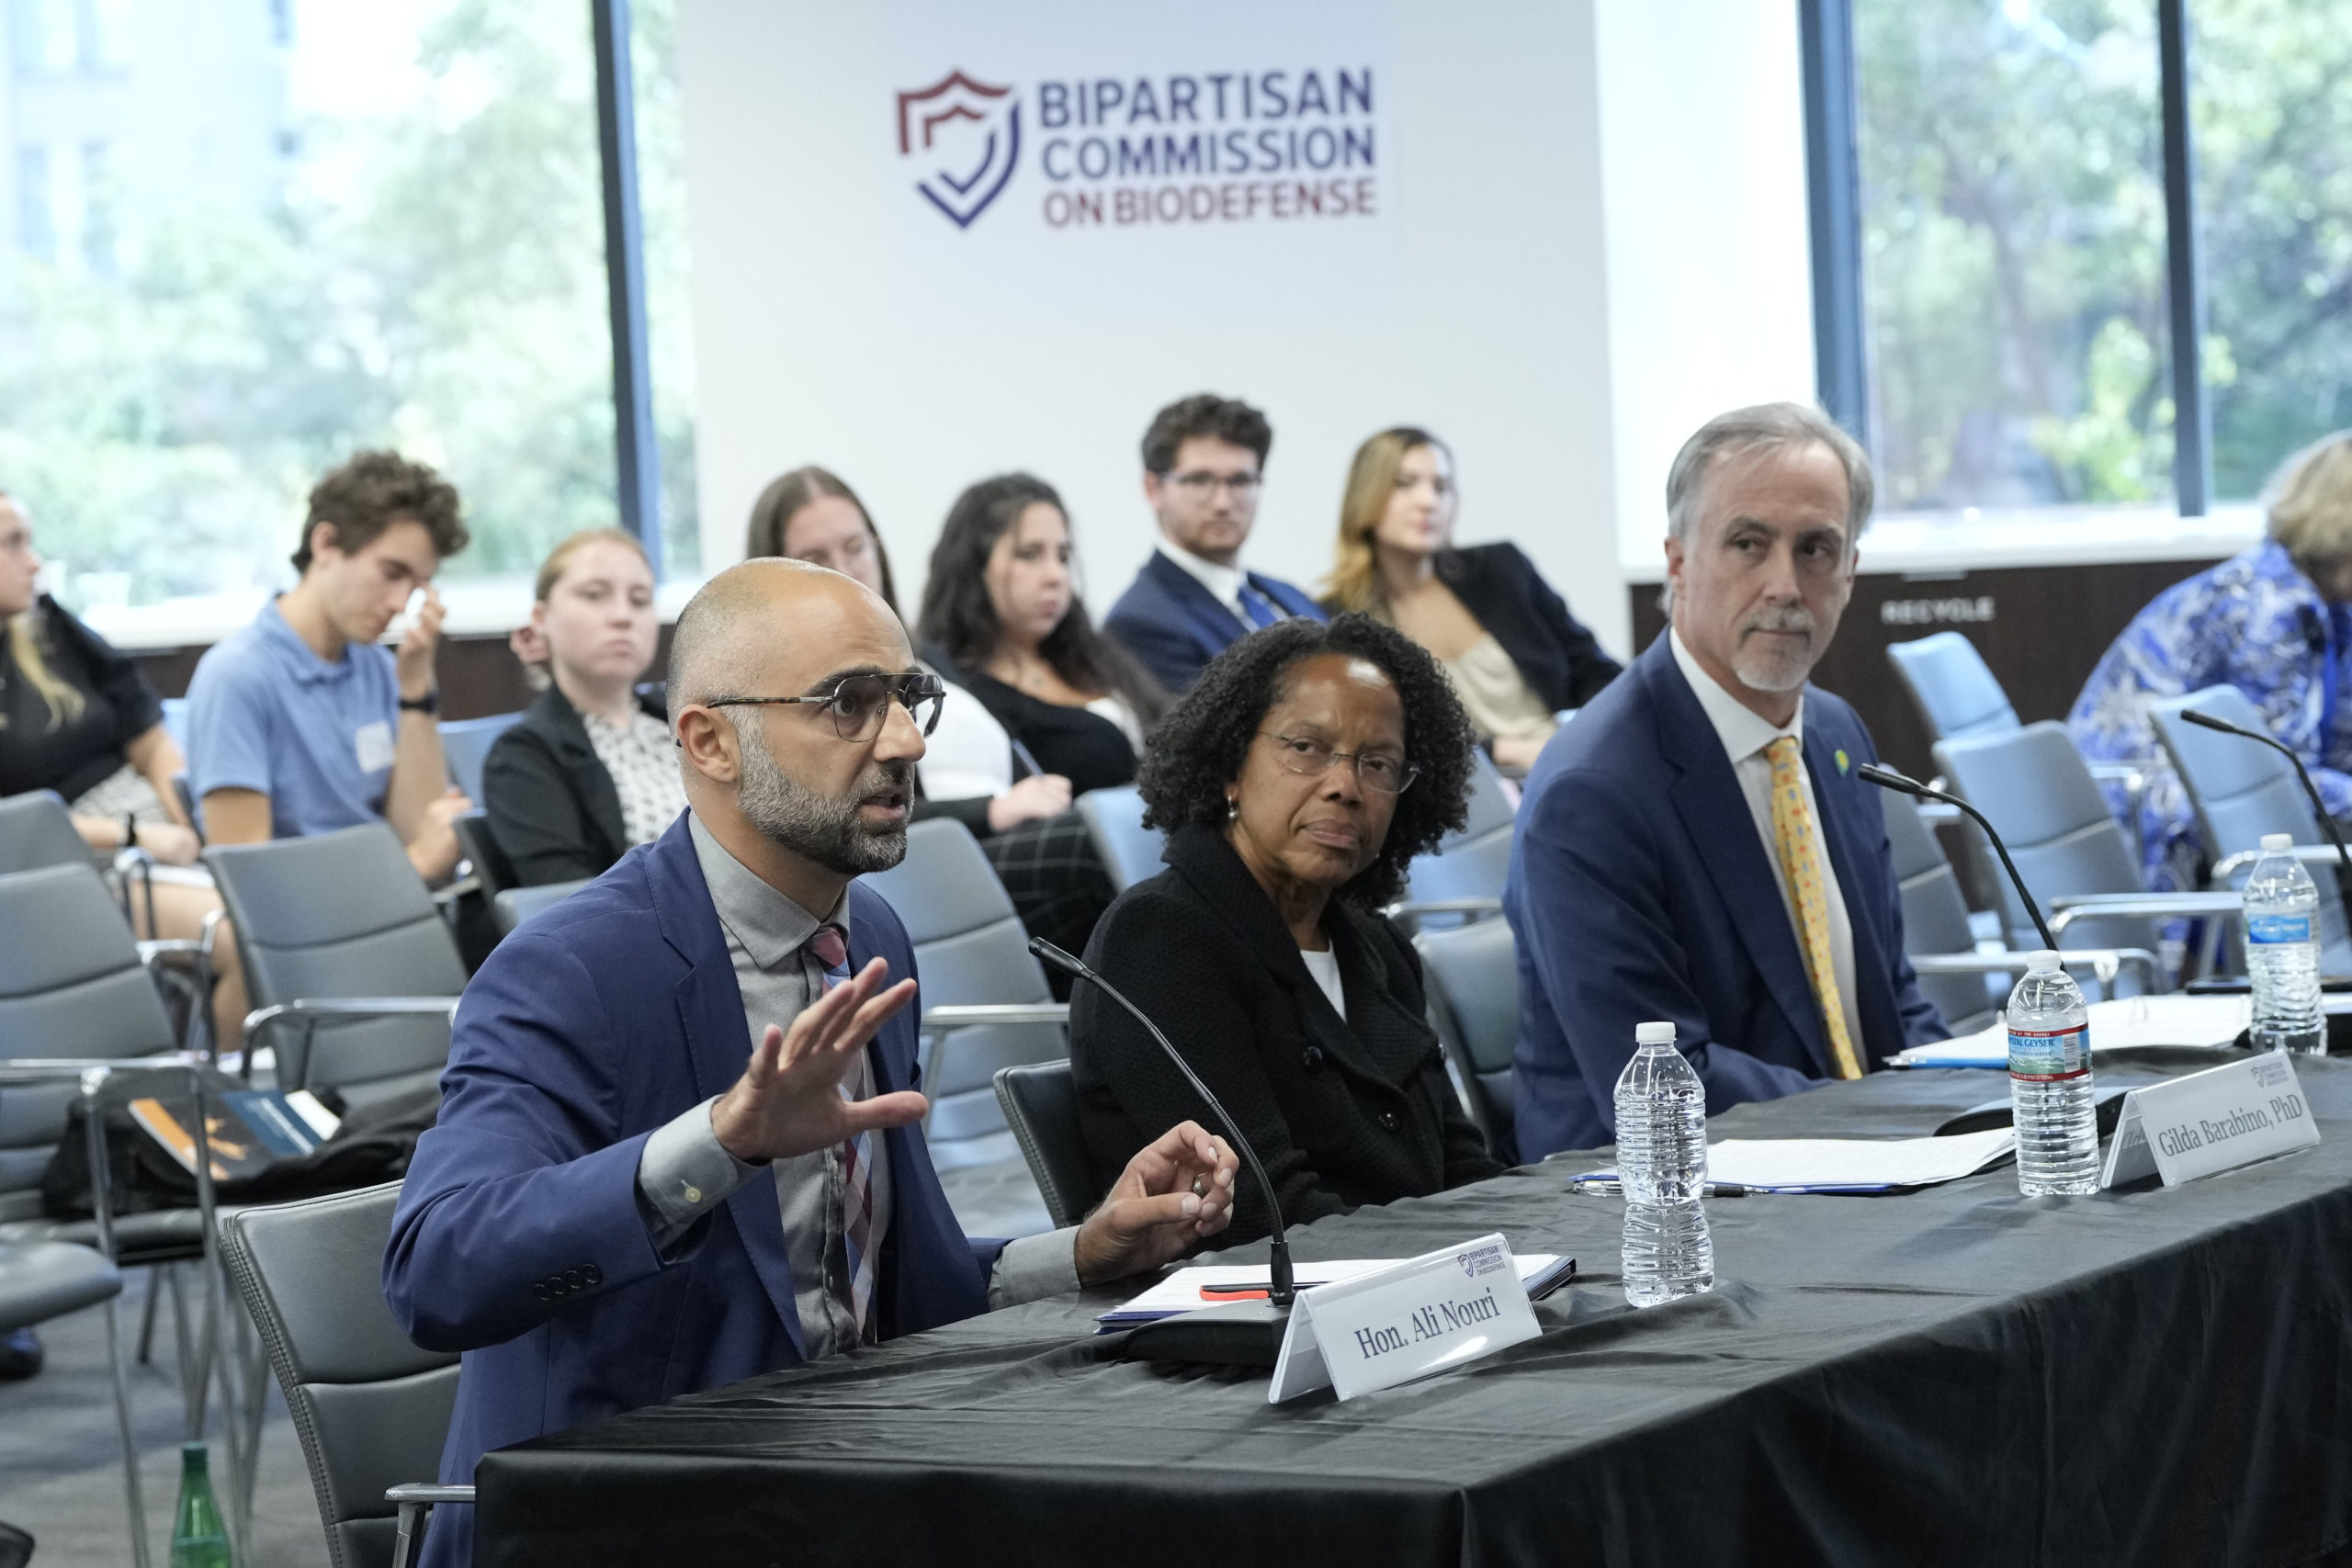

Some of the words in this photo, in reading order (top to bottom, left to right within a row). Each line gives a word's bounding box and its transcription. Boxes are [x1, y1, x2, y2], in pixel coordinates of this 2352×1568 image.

[1039, 67, 1373, 129] BIPARTISAN
[1041, 126, 1374, 182] COMMISSION
[1043, 190, 1102, 228] ON
[1114, 177, 1376, 225] BIODEFENSE
[1882, 596, 1995, 625] RECYCLE
[2024, 1039, 2054, 1047] GEYSER
[2158, 1124, 2203, 1156] Gilda
[2199, 1107, 2275, 1145] Barabino,
[2268, 1094, 2302, 1123] PhD
[1469, 1245, 1499, 1260] BIPARTISAN
[1474, 1255, 1503, 1269] COMMISSION
[1482, 1261, 1507, 1274] BIODEFENSE
[1354, 1327, 1409, 1359] Hon.
[1411, 1305, 1443, 1342] Ali
[1439, 1287, 1501, 1331] Nouri
